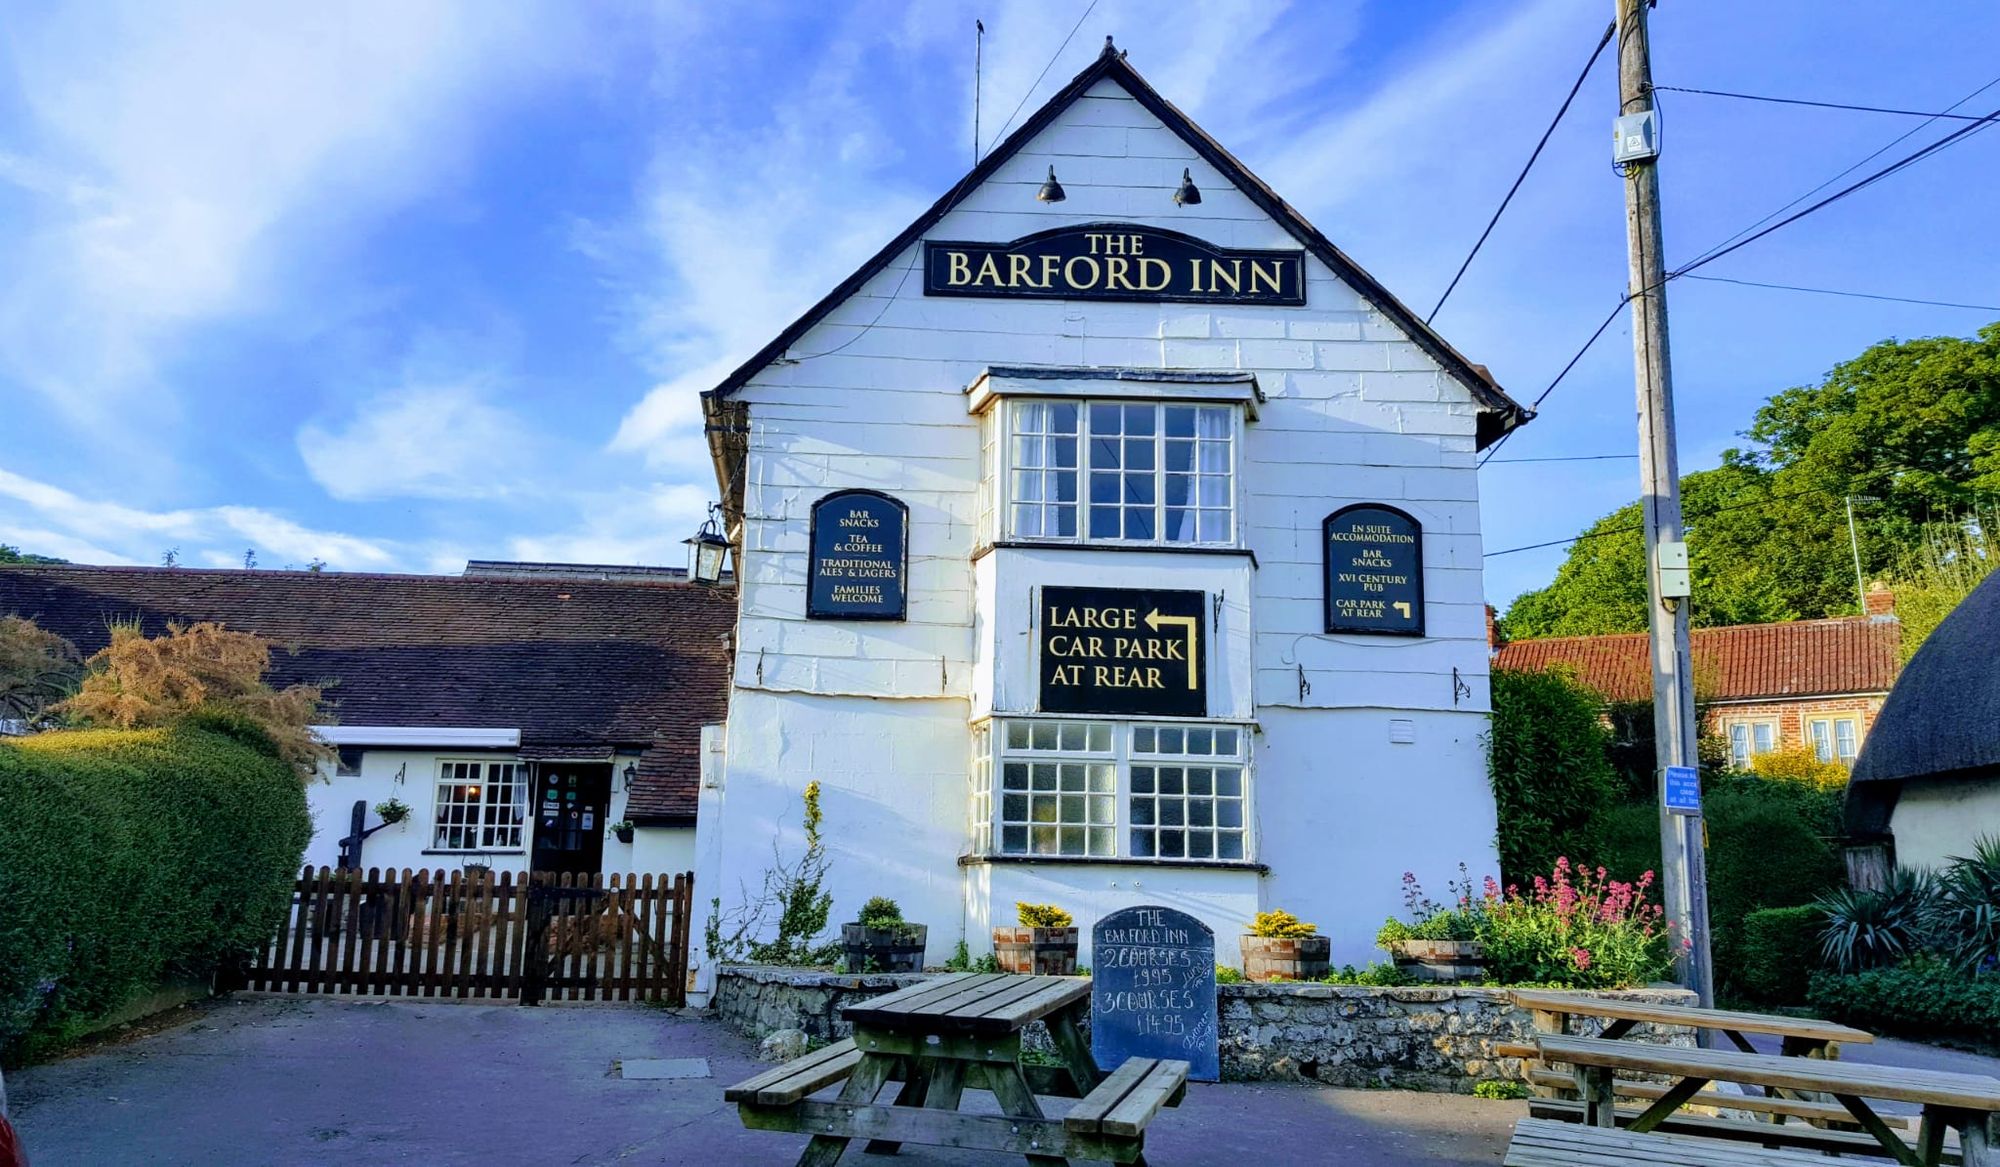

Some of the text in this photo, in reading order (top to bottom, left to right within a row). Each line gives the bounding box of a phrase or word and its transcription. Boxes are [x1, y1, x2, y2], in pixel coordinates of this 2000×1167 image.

[1085, 233, 1143, 255] THE
[947, 252, 1284, 294] BARFORD INN
[850, 510, 869, 518] BAR
[840, 519, 879, 528] SNACKS
[1352, 525, 1391, 534] EN SUITE
[848, 535, 868, 543] TEA
[1331, 533, 1414, 543] ACCOMMODATION
[834, 543, 883, 553] & COFFEE
[1363, 549, 1382, 558] BAR
[821, 559, 893, 569] TRADITIONAL
[1352, 558, 1392, 567] SNACKS
[819, 568, 896, 578] ALES & LAGERS
[1339, 574, 1407, 585] XVI CENTURY
[834, 585, 880, 594] FAMILIES
[1363, 583, 1383, 592] PUB
[832, 594, 883, 603] WELCOME
[1336, 599, 1386, 609] CAR PARK
[1050, 607, 1137, 629] LARGE
[1341, 608, 1383, 618] AT REAR
[1050, 636, 1185, 661] CAR PARK
[1051, 664, 1166, 689] AT REAR
[1136, 909, 1166, 926] THE
[1104, 927, 1189, 944] BARFORD INN
